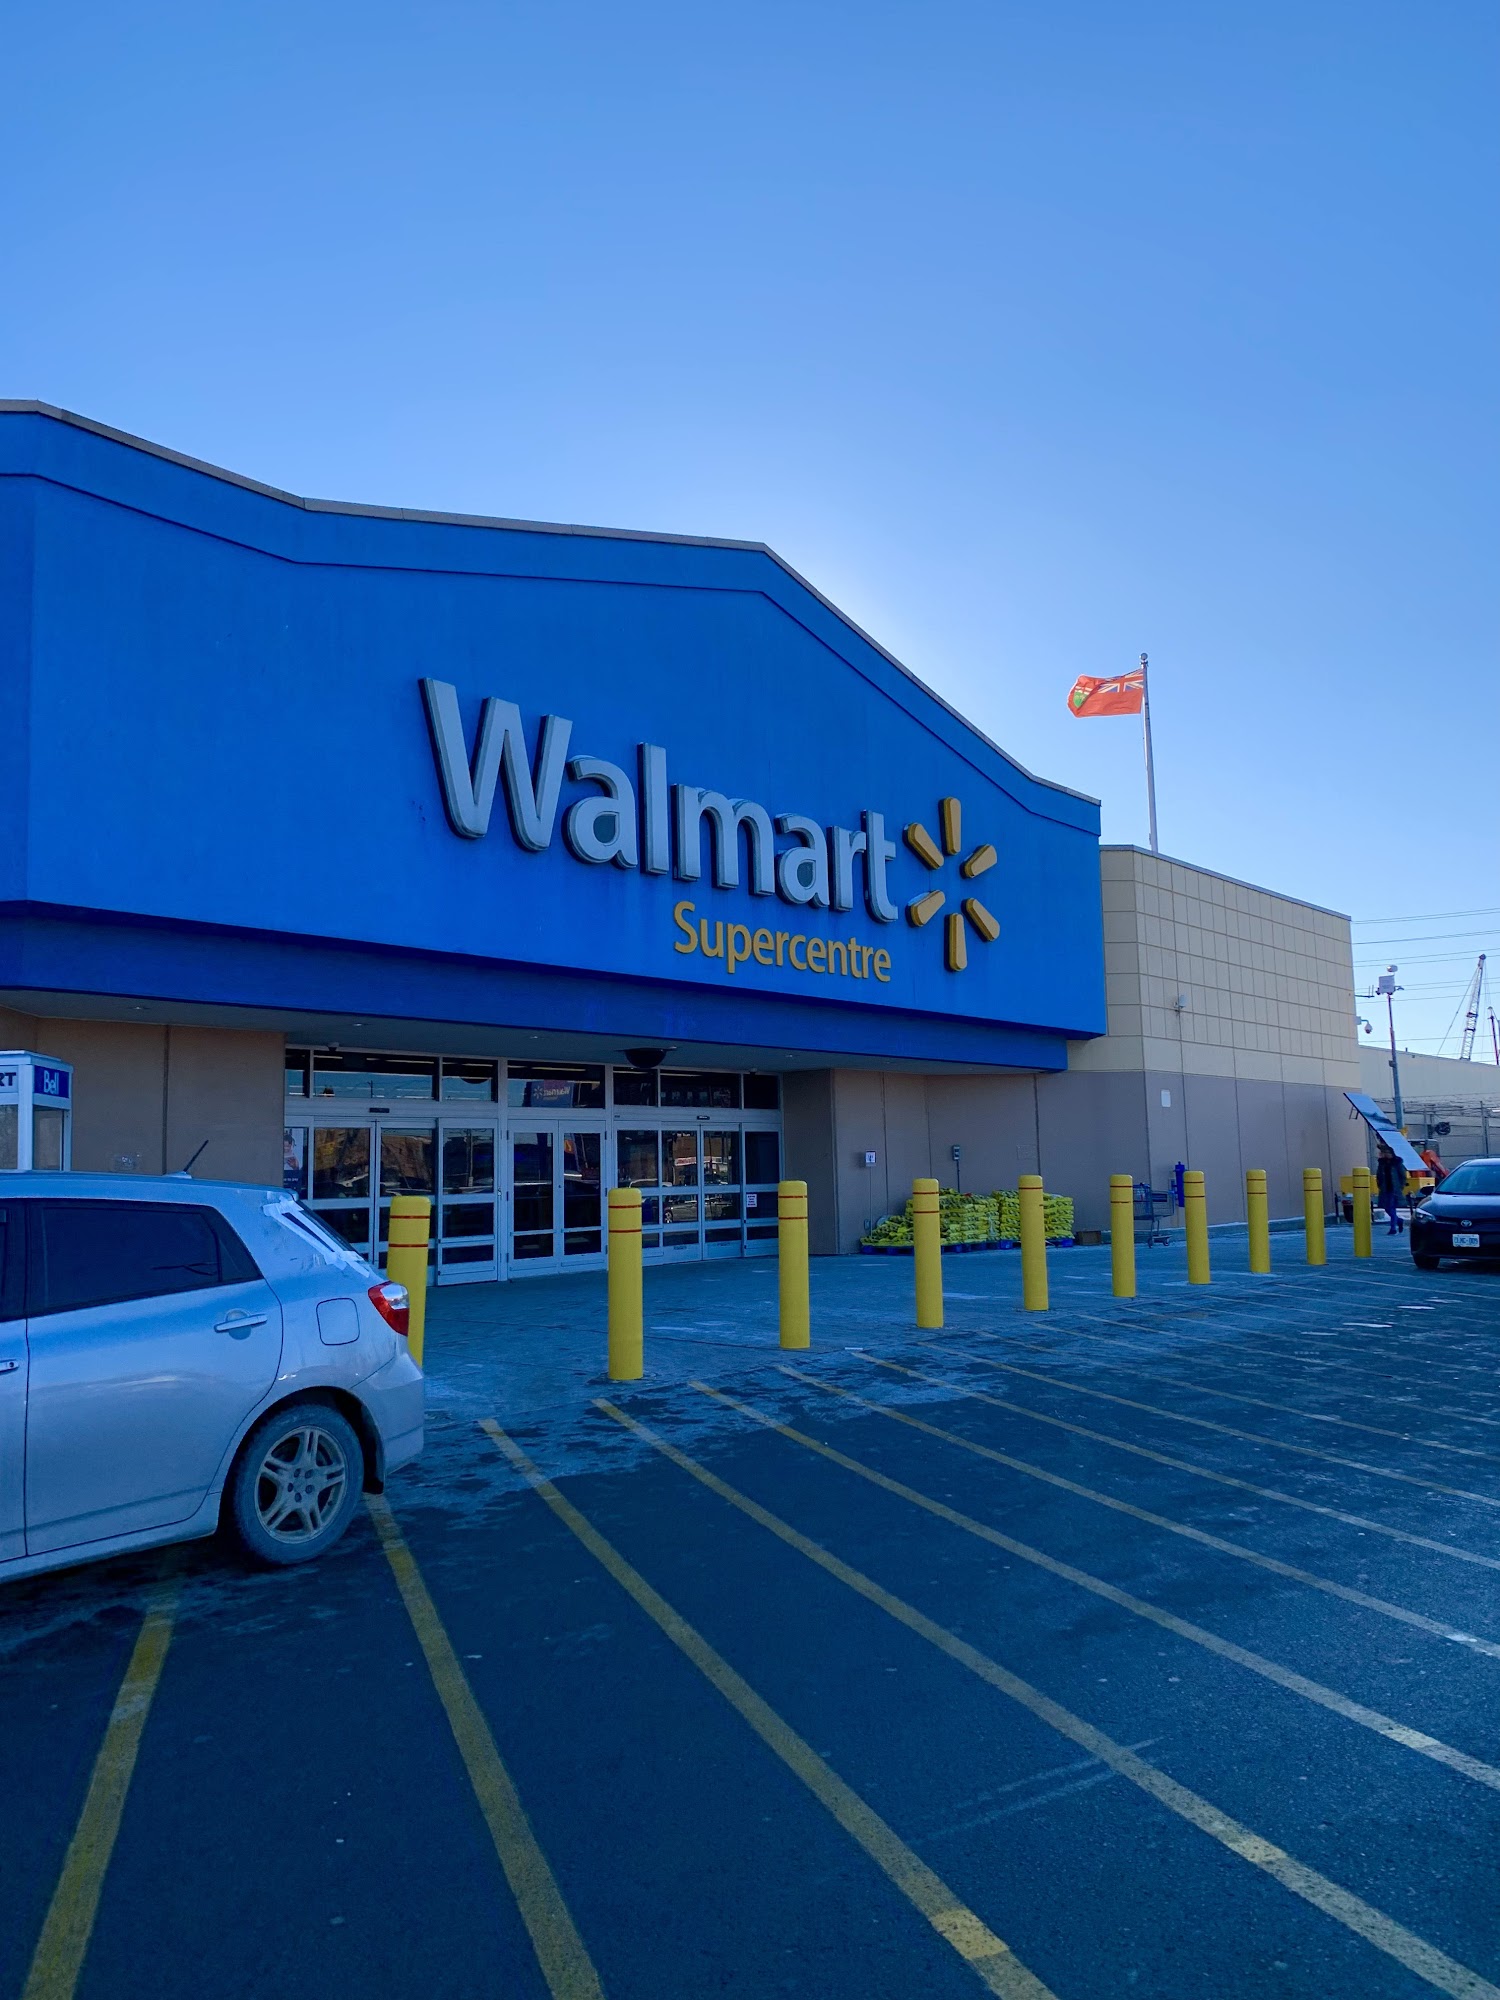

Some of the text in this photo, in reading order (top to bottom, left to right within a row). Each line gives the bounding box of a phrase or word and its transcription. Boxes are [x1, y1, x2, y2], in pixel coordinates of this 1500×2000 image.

[420, 677, 898, 922] Walmart
[673, 901, 892, 982] Supercentre
[43, 1070, 59, 1095] Bell
